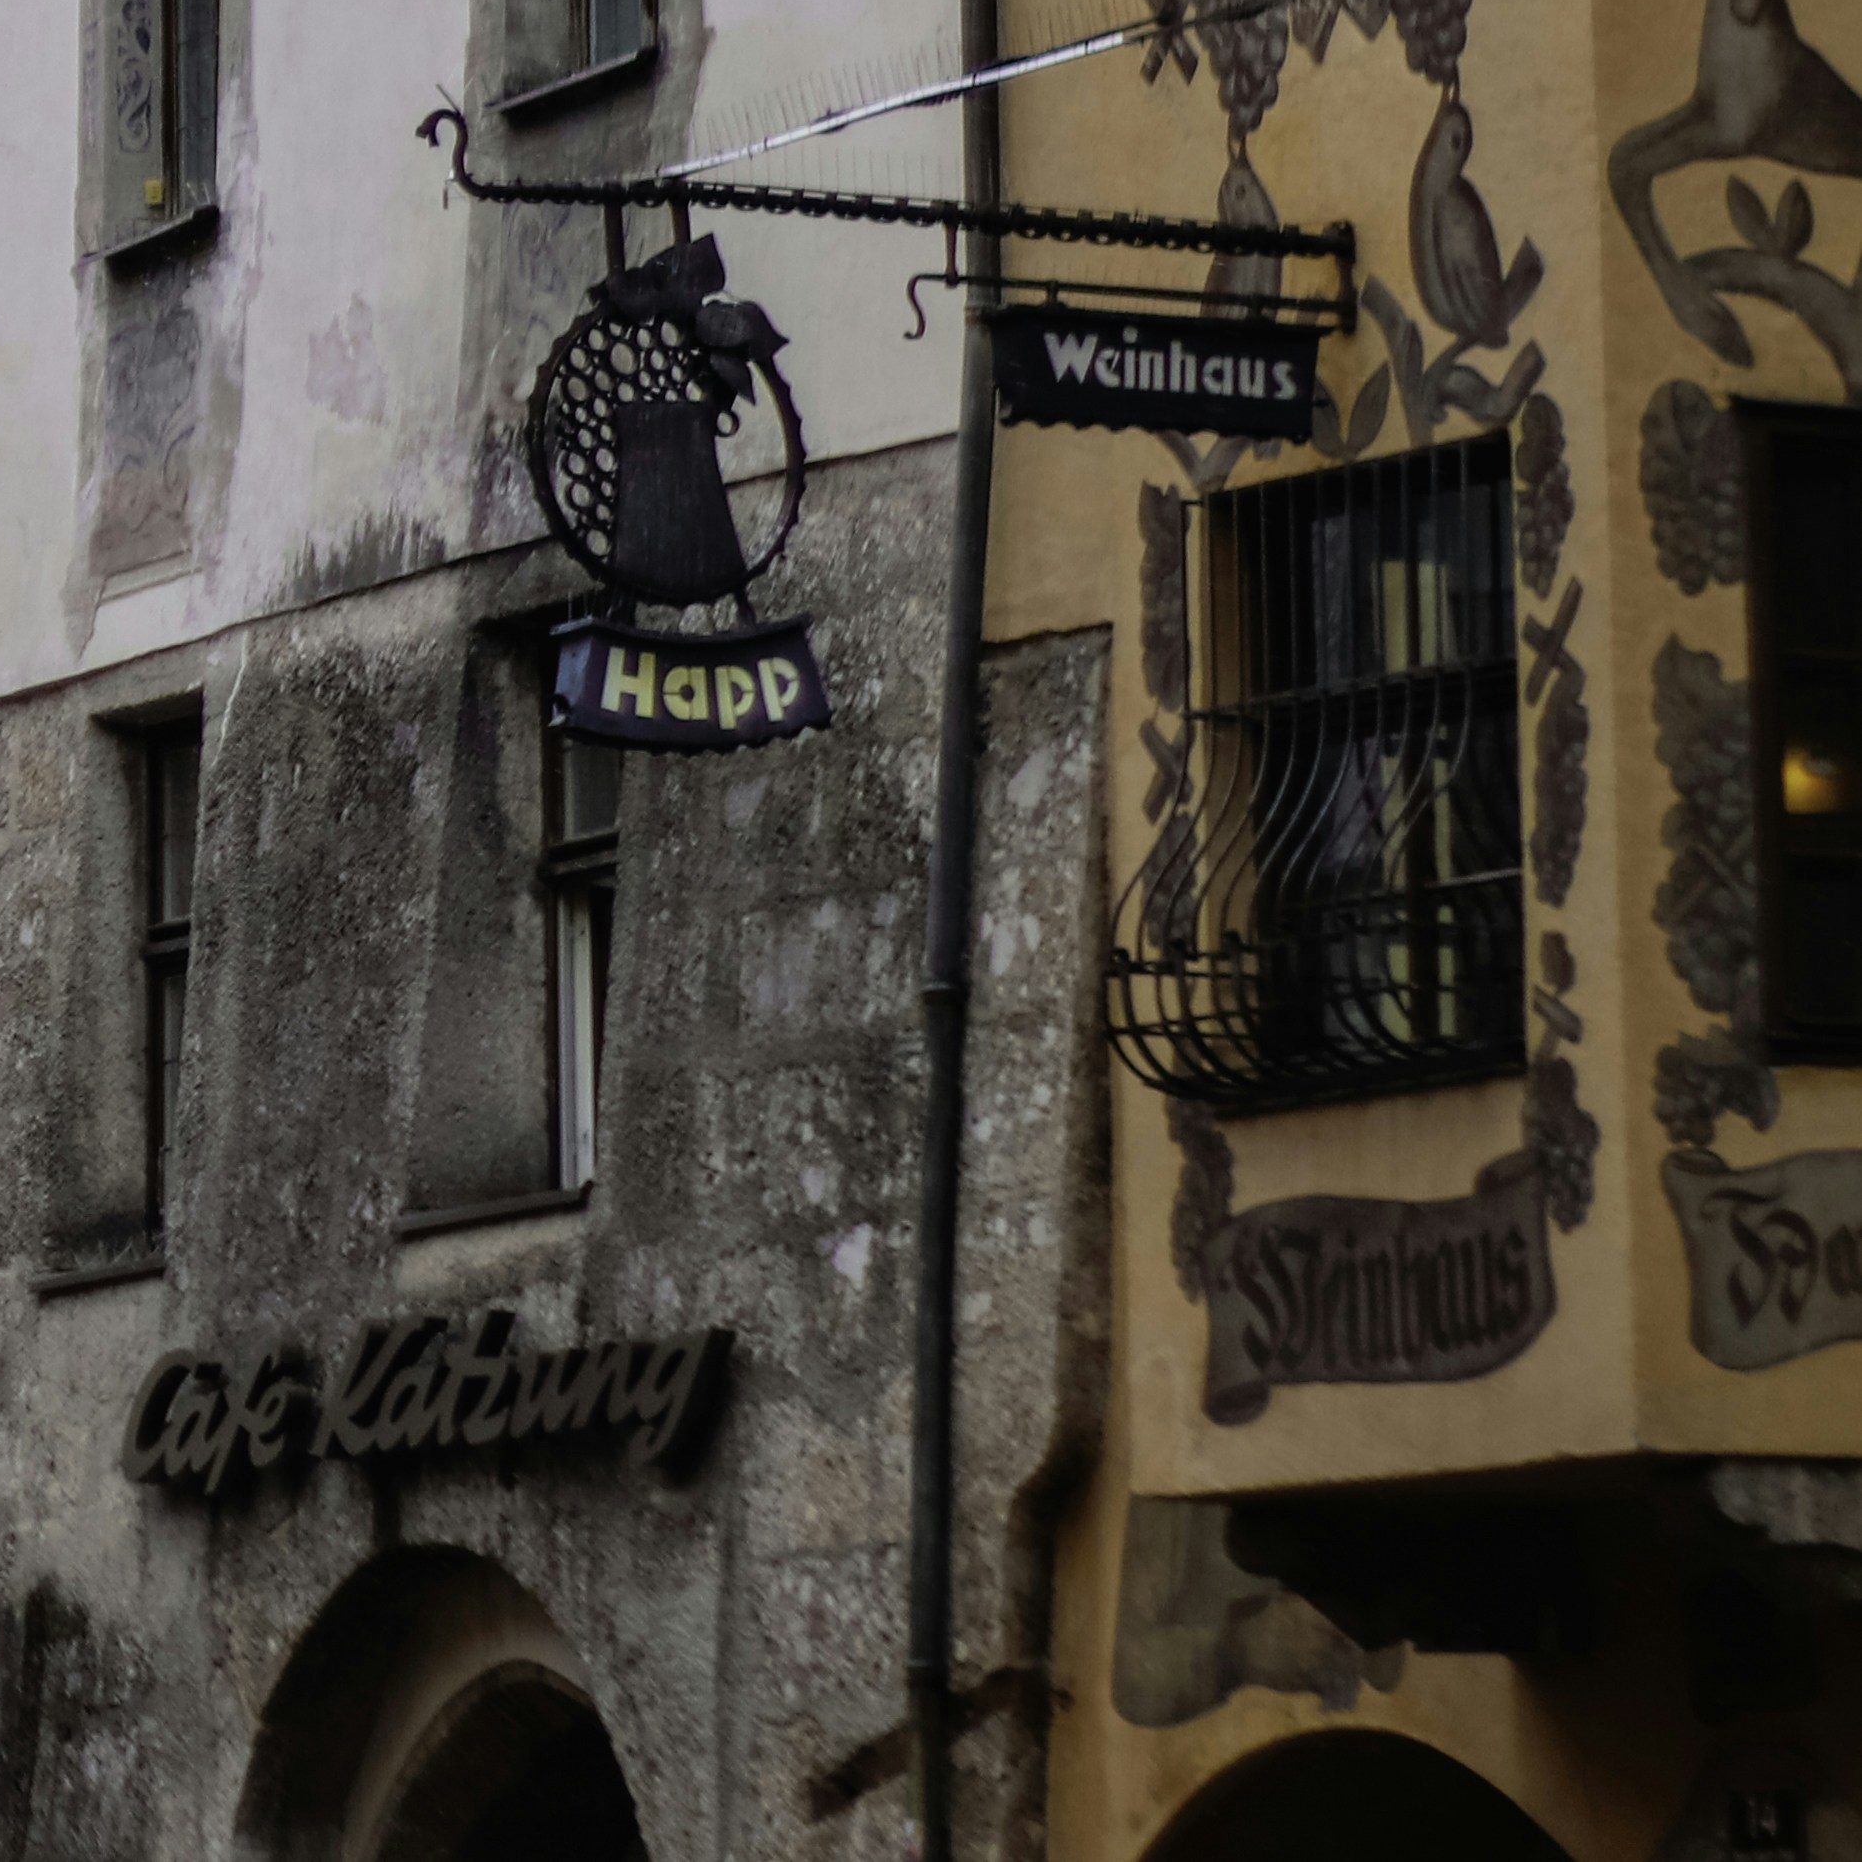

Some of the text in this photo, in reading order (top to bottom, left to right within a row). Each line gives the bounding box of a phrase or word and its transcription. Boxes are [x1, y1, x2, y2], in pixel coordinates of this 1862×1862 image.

[1043, 325, 1299, 402] Weinhaus
[599, 645, 801, 731] Happ
[1218, 1221, 1532, 1371] Weinhaus
[1700, 1186, 1862, 1330] Ha
[312, 1312, 726, 1466] Katzung
